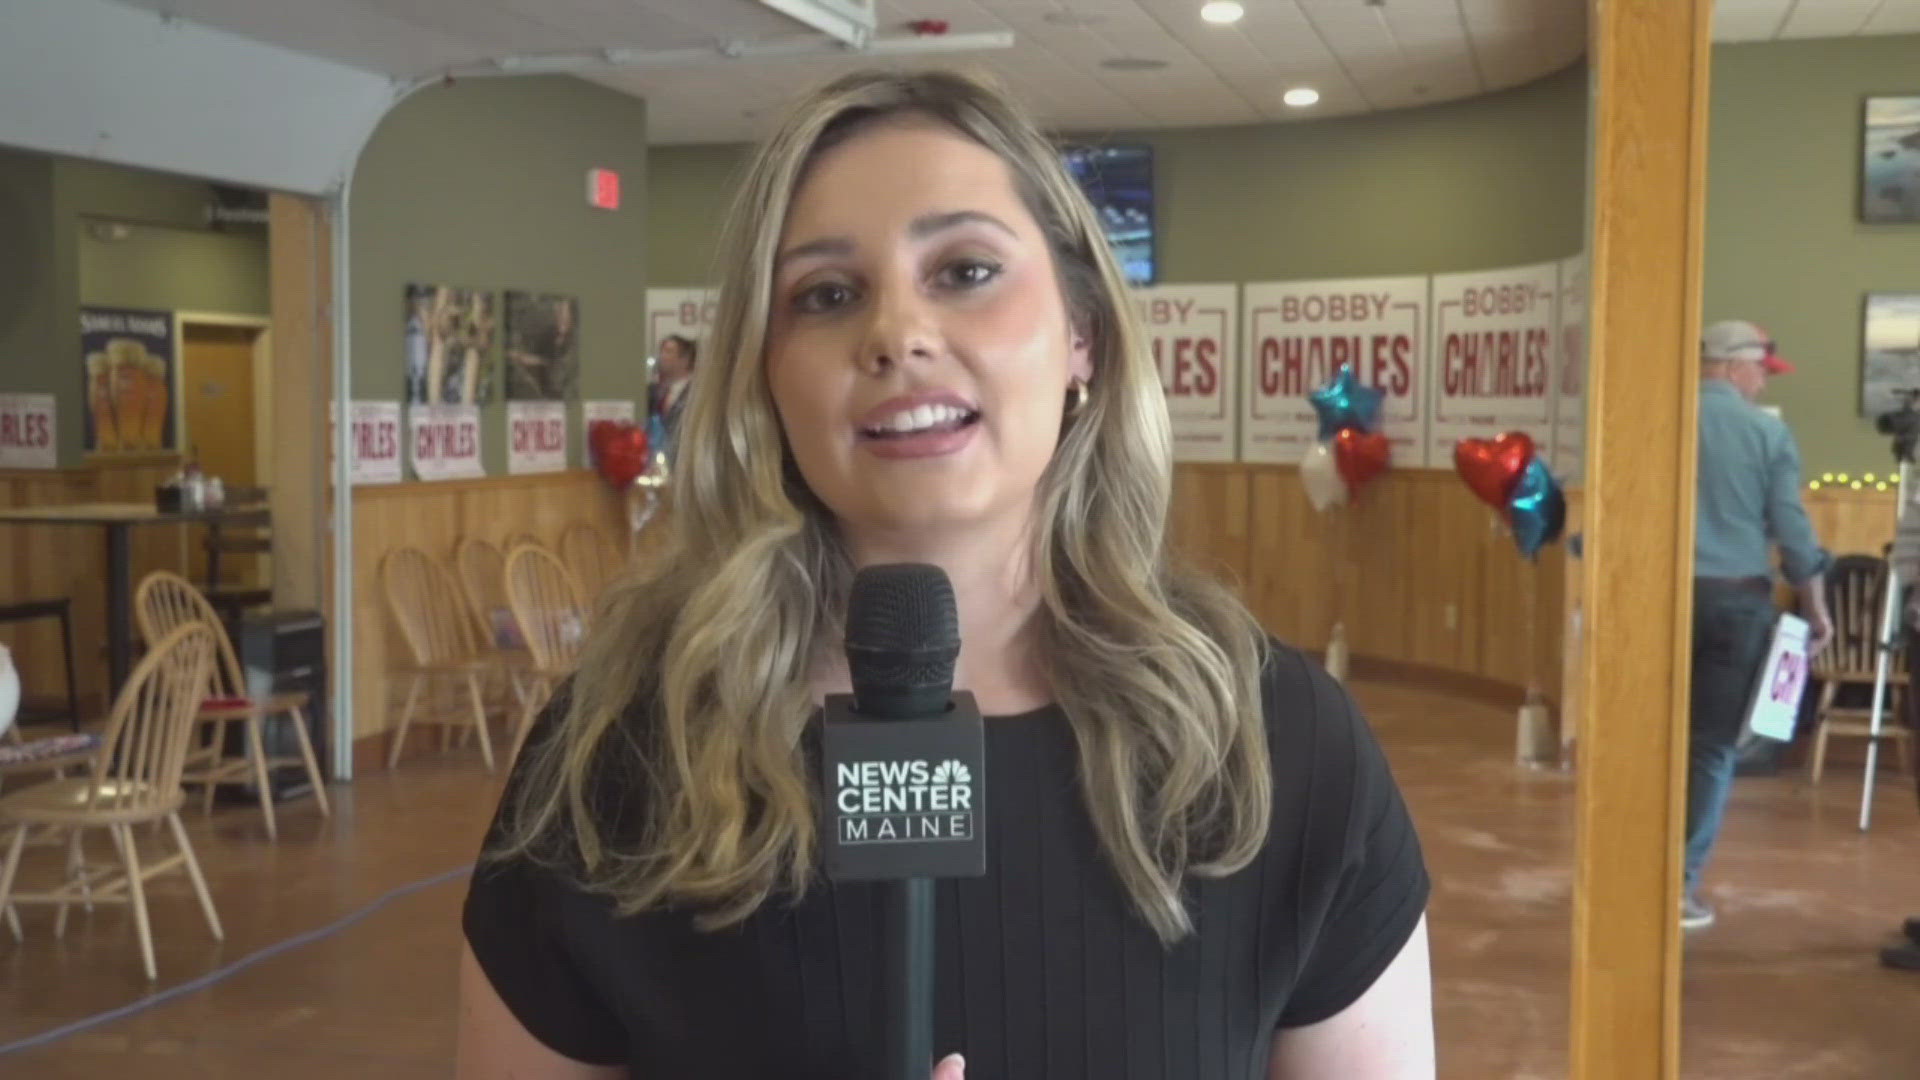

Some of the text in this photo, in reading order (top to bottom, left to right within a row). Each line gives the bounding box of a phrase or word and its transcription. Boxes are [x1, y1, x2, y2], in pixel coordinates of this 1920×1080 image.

[1281, 292, 1391, 322] BOBBY
[1446, 328, 1547, 396] CHARLES
[837, 760, 929, 787] NEWS
[837, 784, 973, 813] CENTER
[846, 815, 966, 840] MAINE
